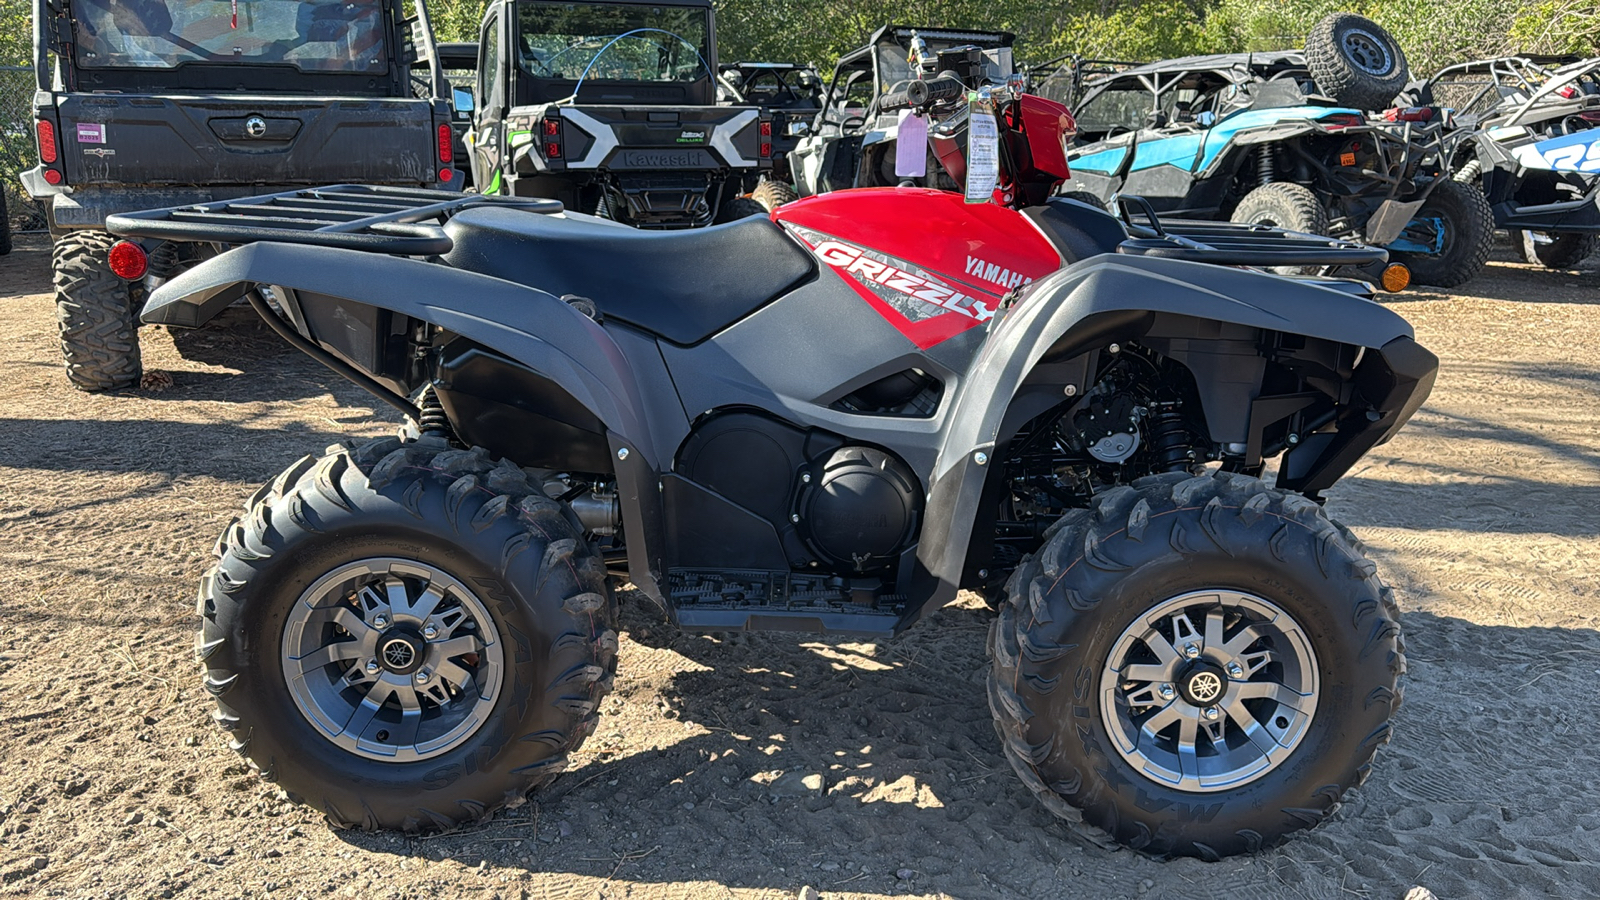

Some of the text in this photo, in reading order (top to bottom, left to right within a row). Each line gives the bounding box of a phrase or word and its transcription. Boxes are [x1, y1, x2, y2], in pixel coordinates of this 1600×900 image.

[624, 151, 704, 167] Kawasaki
[814, 240, 997, 321] GRIZZLY
[422, 576, 535, 792] MAXXIS
[1072, 665, 1226, 824] MAXXIS
